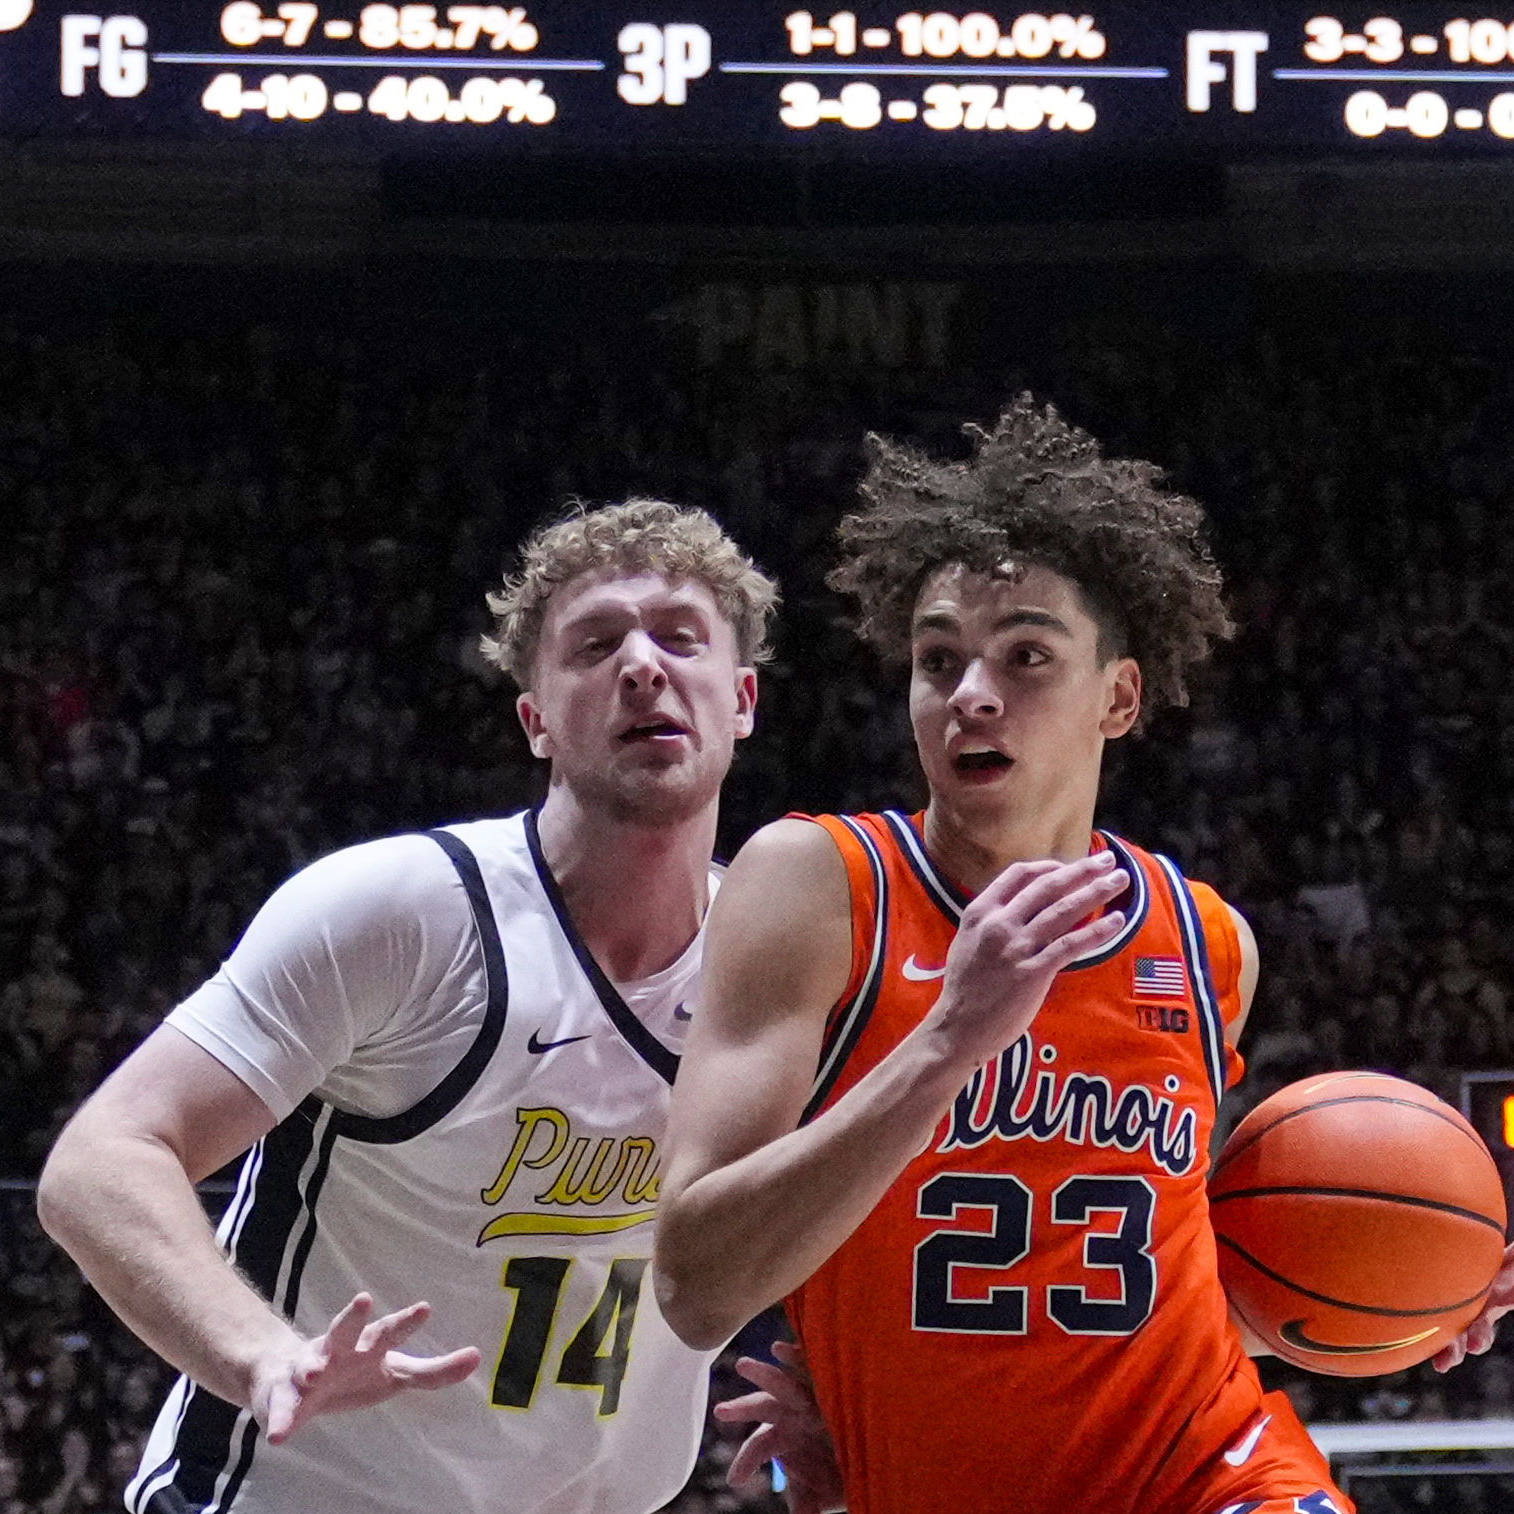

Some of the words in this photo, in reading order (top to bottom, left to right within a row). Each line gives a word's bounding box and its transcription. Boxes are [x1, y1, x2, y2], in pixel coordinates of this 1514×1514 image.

[61, 14, 148, 98] FG
[219, 1, 318, 46] 6-7
[359, 4, 538, 50] 85.7%
[617, 23, 712, 105] 3P
[785, 11, 856, 55] 1-1
[896, 12, 1106, 59] 100.0%
[1304, 17, 1404, 62] 3-3
[202, 73, 328, 120] 4-10
[367, 76, 556, 124] 40.0%
[1187, 30, 1269, 112] FT
[936, 1028, 1198, 1177] llinois
[911, 1172, 1158, 1336] 23
[491, 1256, 650, 1417] 14
